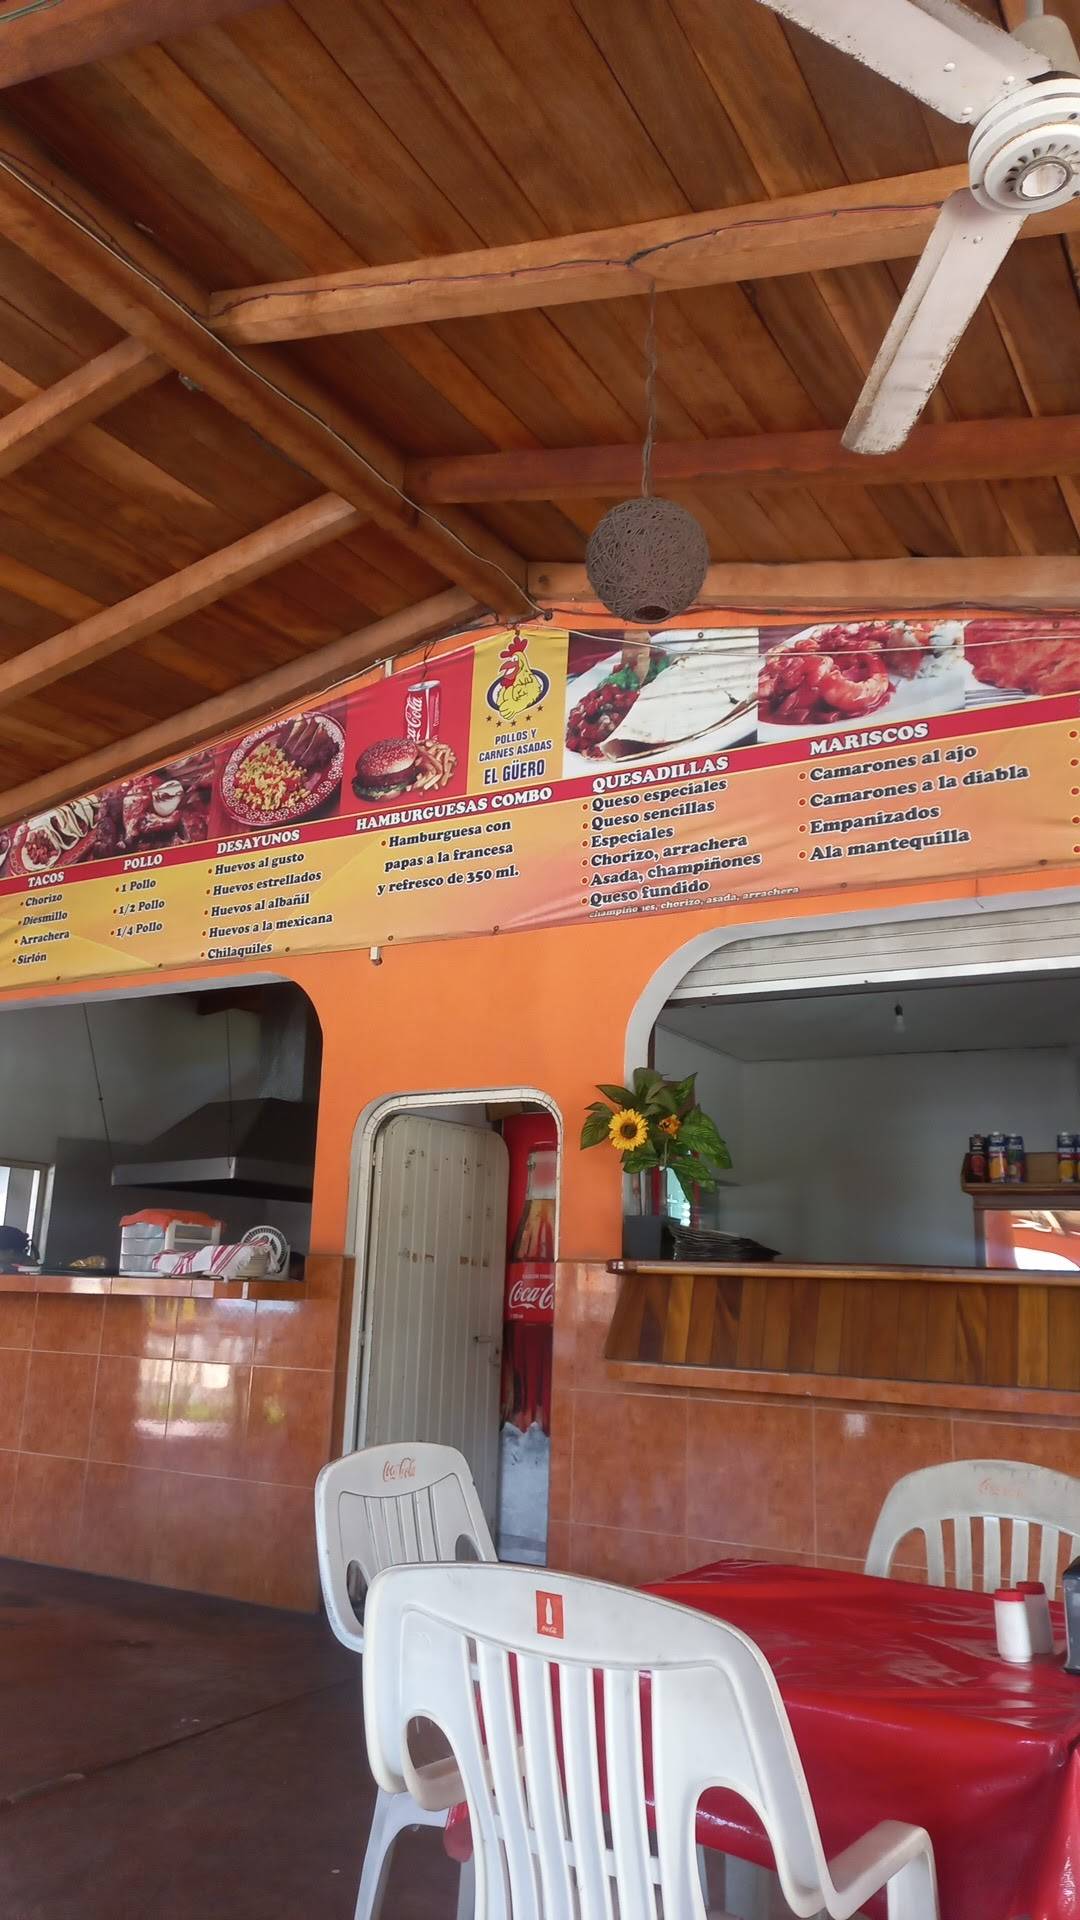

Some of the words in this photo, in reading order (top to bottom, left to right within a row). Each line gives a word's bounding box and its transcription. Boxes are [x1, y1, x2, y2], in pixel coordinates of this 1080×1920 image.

[495, 730, 528, 745] POLLOS
[531, 728, 537, 738] Y
[810, 722, 929, 756] MARISCOS
[479, 747, 514, 762] CARNES
[517, 740, 552, 755] ASADAS
[810, 755, 917, 781] Camarones
[921, 750, 941, 764] al
[945, 745, 977, 764] ajo
[484, 768, 498, 784] EL
[503, 759, 545, 781] GÜERO
[592, 756, 729, 793] QUESADILLAS
[591, 795, 640, 812] Queso
[644, 780, 727, 802] especiales
[810, 782, 917, 807] Camarones
[922, 781, 933, 791] a
[938, 775, 957, 789] la
[962, 765, 1029, 786] diabla
[356, 796, 488, 831] HAMBURGUESAS
[491, 787, 552, 807] COMBO
[591, 813, 639, 831] Queso
[643, 801, 715, 821] sencillas
[810, 806, 940, 834] Empanizados
[217, 830, 300, 854] DESAYUNOS
[389, 823, 482, 848] Hamburguesa
[486, 820, 511, 833] con
[591, 826, 674, 848] Especiales
[809, 845, 843, 861] Ala
[847, 828, 970, 857] mantequilla
[124, 854, 163, 870] POLLO
[384, 856, 423, 873] papas
[426, 855, 434, 865] a
[437, 849, 449, 863] la
[453, 842, 513, 861] francesa
[591, 849, 659, 867] Chorizo,
[663, 836, 748, 857] arrachera
[215, 861, 255, 875] Huevos
[258, 857, 269, 868] al
[271, 853, 304, 868] gusto
[590, 870, 644, 887] Asada,
[647, 853, 761, 879] champiñones
[28, 872, 64, 888] TACOS
[121, 884, 126, 892] 1
[130, 879, 156, 891] Pollo
[213, 882, 253, 896] Huevos
[256, 871, 322, 889] estrellados
[377, 883, 385, 895] y
[388, 874, 444, 892] refresco
[447, 869, 464, 884] de
[466, 869, 491, 883] 350
[495, 864, 520, 879] ml.
[25, 893, 63, 907] Chorizo
[211, 902, 251, 917] Huevos
[254, 899, 265, 911] al
[268, 893, 310, 909] albañil
[589, 890, 638, 907] Queso
[641, 879, 710, 900] fundido
[742, 886, 800, 900] arrachera
[23, 910, 68, 926] Diesmillo
[119, 903, 136, 915] 1/2
[138, 899, 165, 911] Pollo
[20, 930, 70, 945] Arrachera
[117, 925, 133, 937] 1/4
[136, 921, 163, 934] Pollo
[209, 923, 250, 938] Huevos
[252, 924, 259, 932] a
[262, 920, 273, 931] la
[275, 914, 333, 930] mexicana
[17, 952, 47, 965] Sirlón
[207, 943, 272, 959] Chilaquiles
